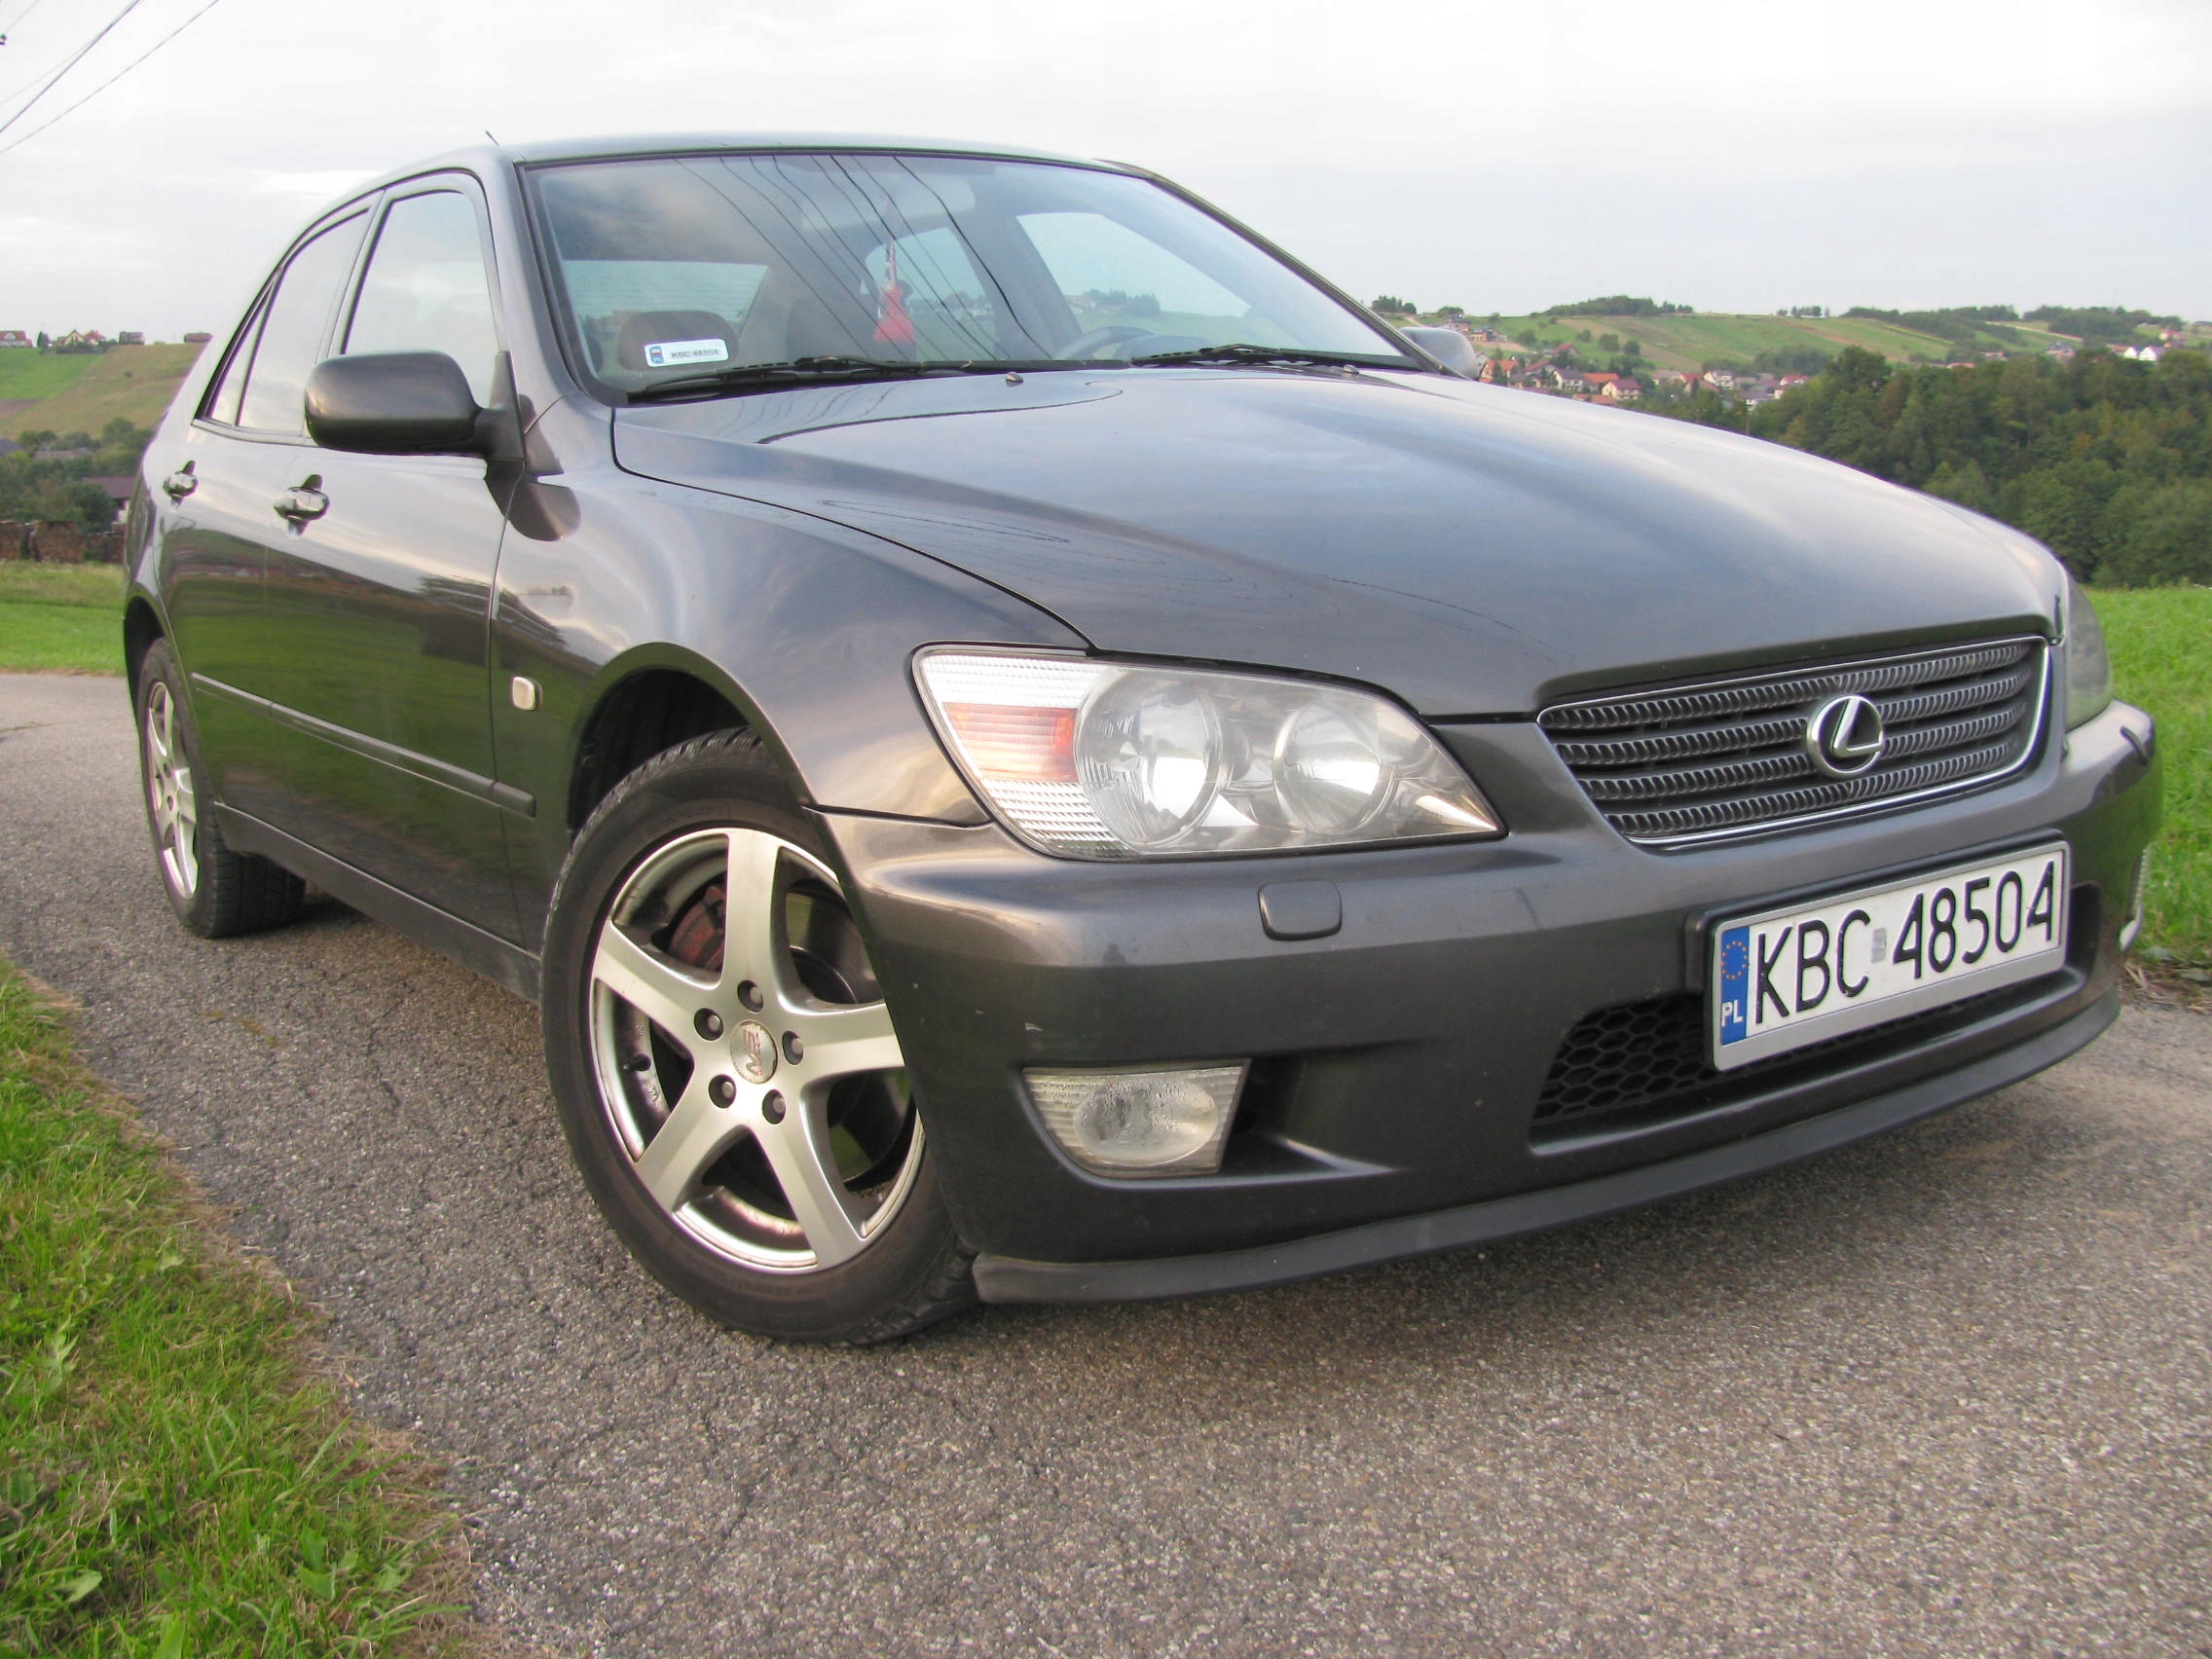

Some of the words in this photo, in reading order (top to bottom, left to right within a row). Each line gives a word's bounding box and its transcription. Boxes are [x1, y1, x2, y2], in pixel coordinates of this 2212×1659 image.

[1754, 908, 1871, 1025] KBC
[1892, 860, 2054, 980] 48504
[1720, 1001, 1744, 1027] PL
